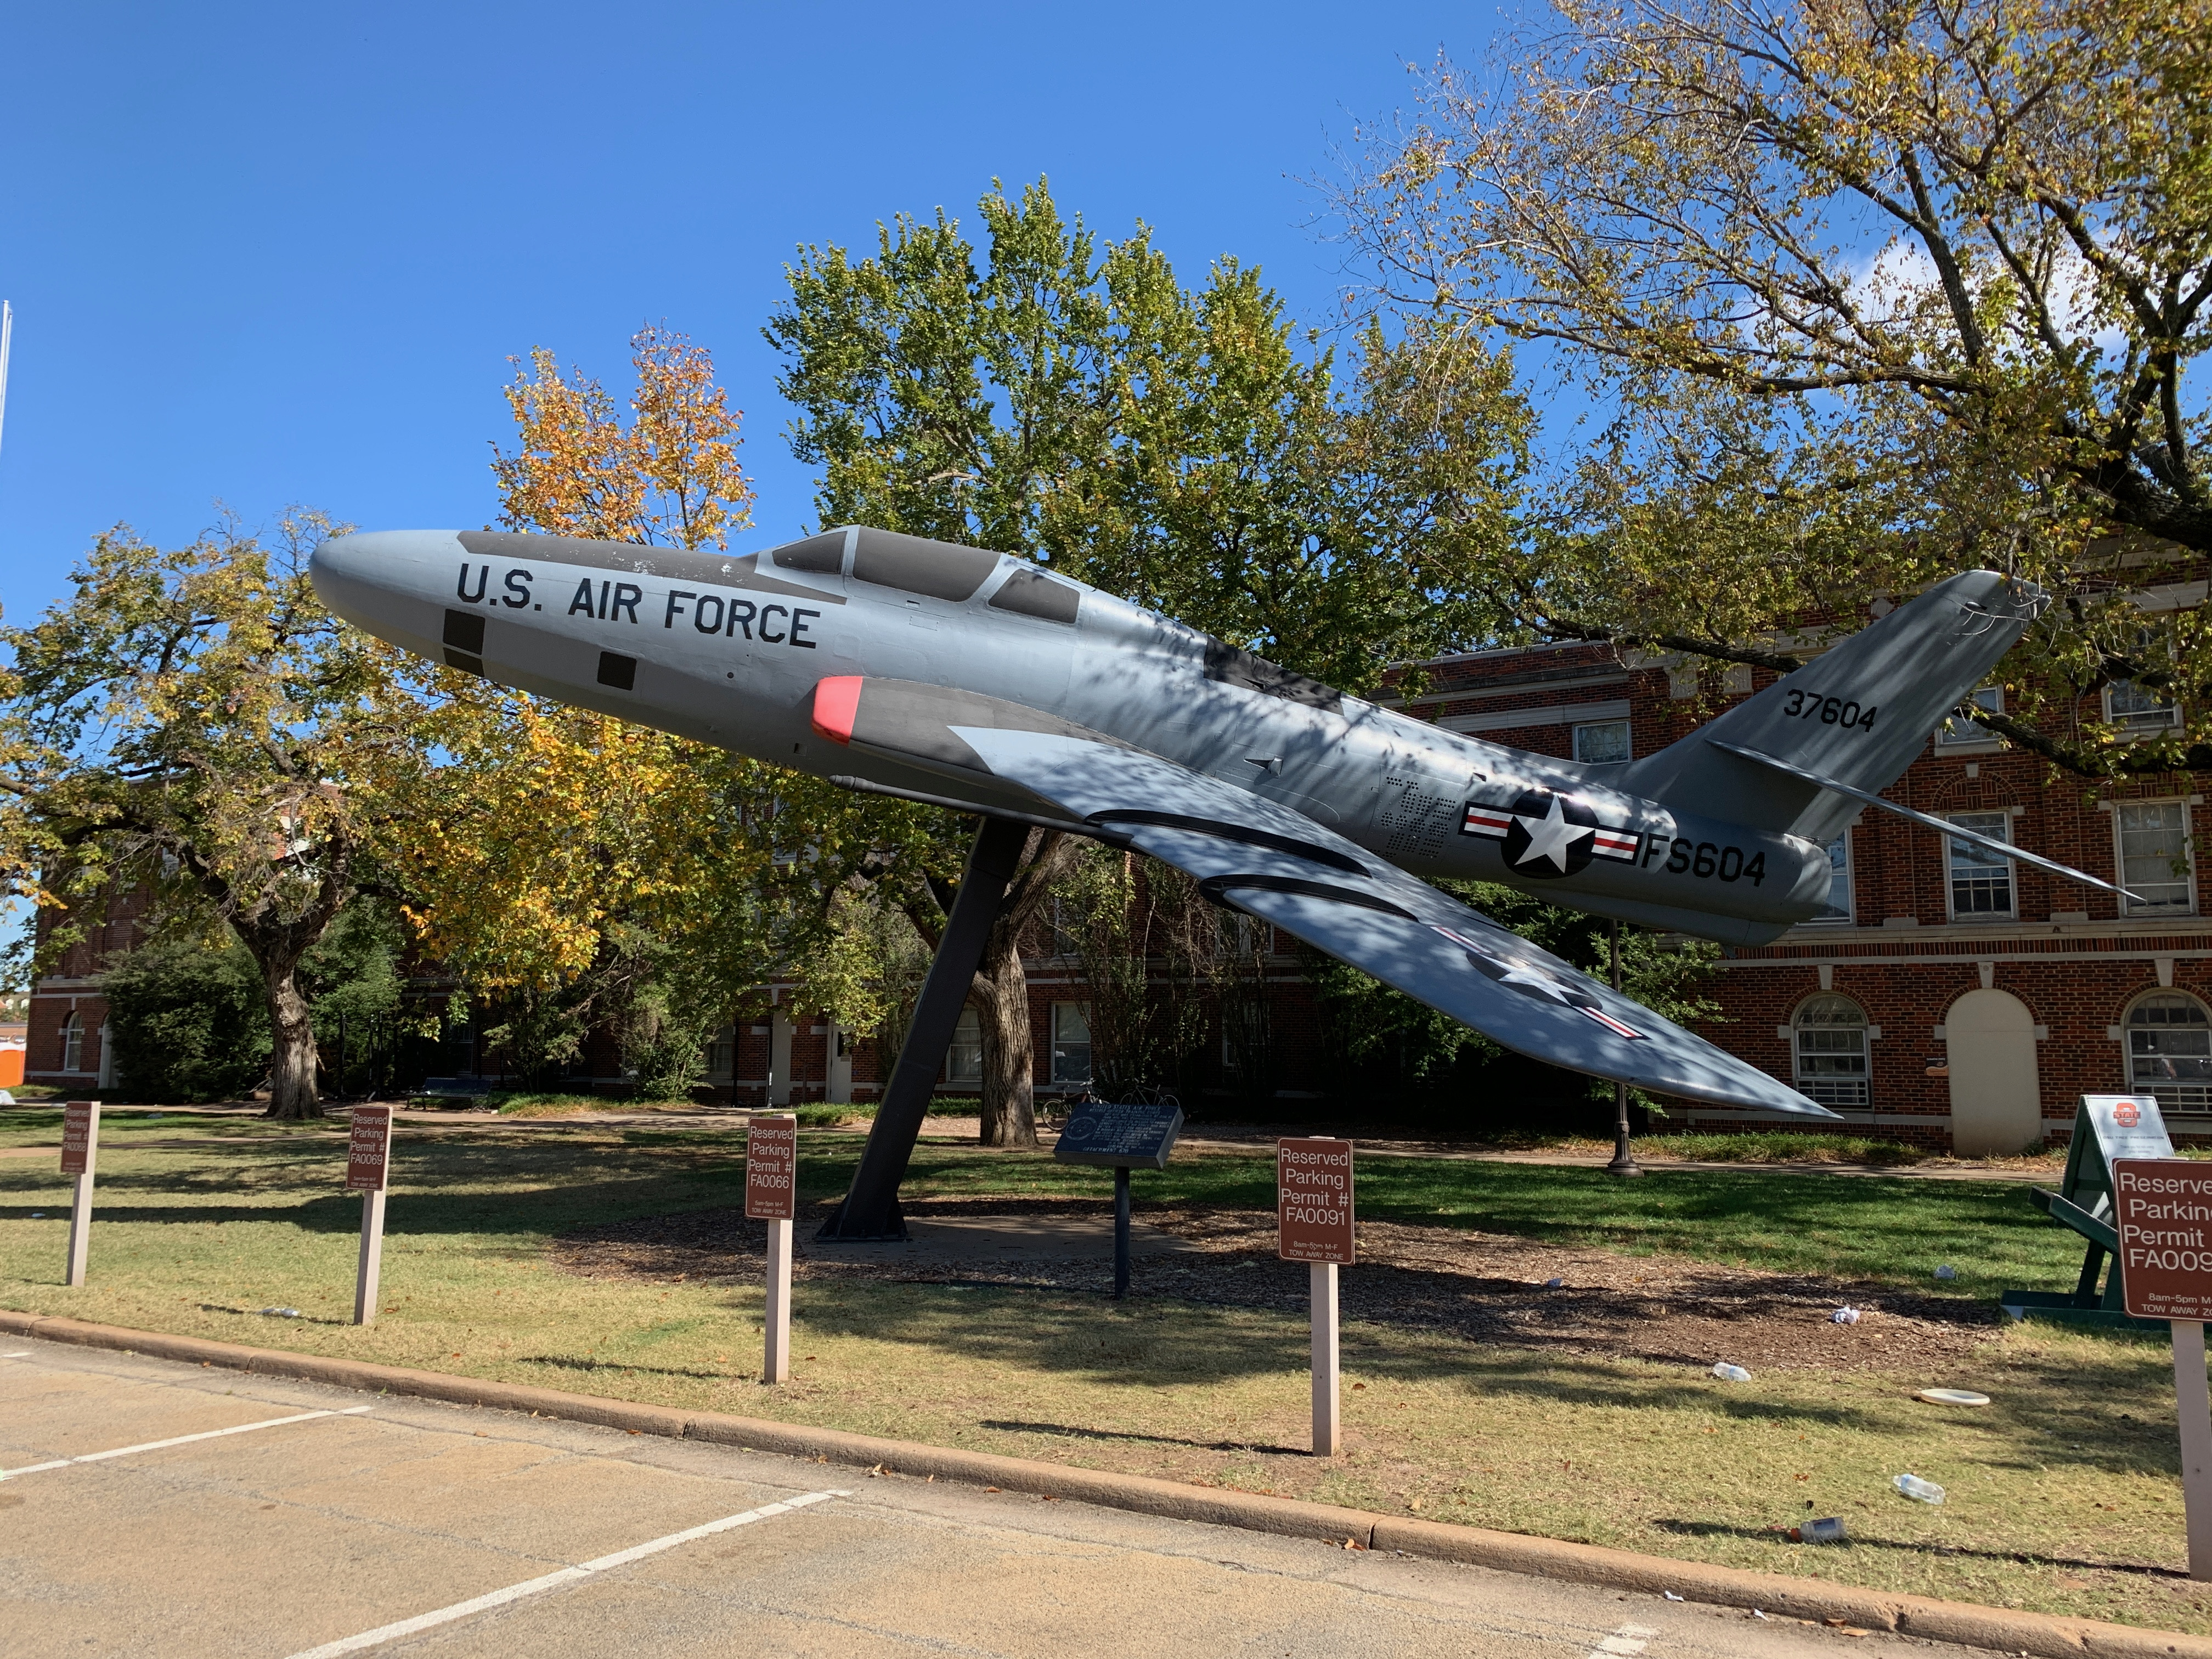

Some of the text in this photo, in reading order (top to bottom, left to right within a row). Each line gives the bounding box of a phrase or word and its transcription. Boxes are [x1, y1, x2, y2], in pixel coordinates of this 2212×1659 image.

[457, 563, 822, 649] U.S. AIR FORCE
[1784, 689, 1877, 732] 37604
[1641, 833, 1765, 887] FS604
[66, 1108, 91, 1117] Reserved
[353, 1114, 387, 1125] Reserved
[66, 1119, 88, 1131] Parking
[64, 1131, 81, 1141] Permit
[354, 1127, 384, 1141] Parking
[750, 1126, 793, 1139] Reserved
[351, 1141, 385, 1153] Permit #
[753, 1142, 790, 1159] Parking
[351, 1153, 383, 1165] FA0069
[1281, 1148, 1348, 1166] Reserved
[749, 1159, 792, 1173] Permit #
[751, 1174, 789, 1189] FA0066
[1286, 1168, 1344, 1190] Parking
[1281, 1188, 1349, 1207] Permit #
[1286, 1206, 1345, 1226] FA0091
[2130, 1199, 2212, 1221] Parkin
[2123, 1224, 2205, 1248] Permit
[1294, 1241, 1323, 1250] 8am-5pm
[2149, 1293, 2197, 1304] 8am-5pm
[2141, 1304, 2166, 1313] TOW
[2170, 1306, 2198, 1315] AWAY
